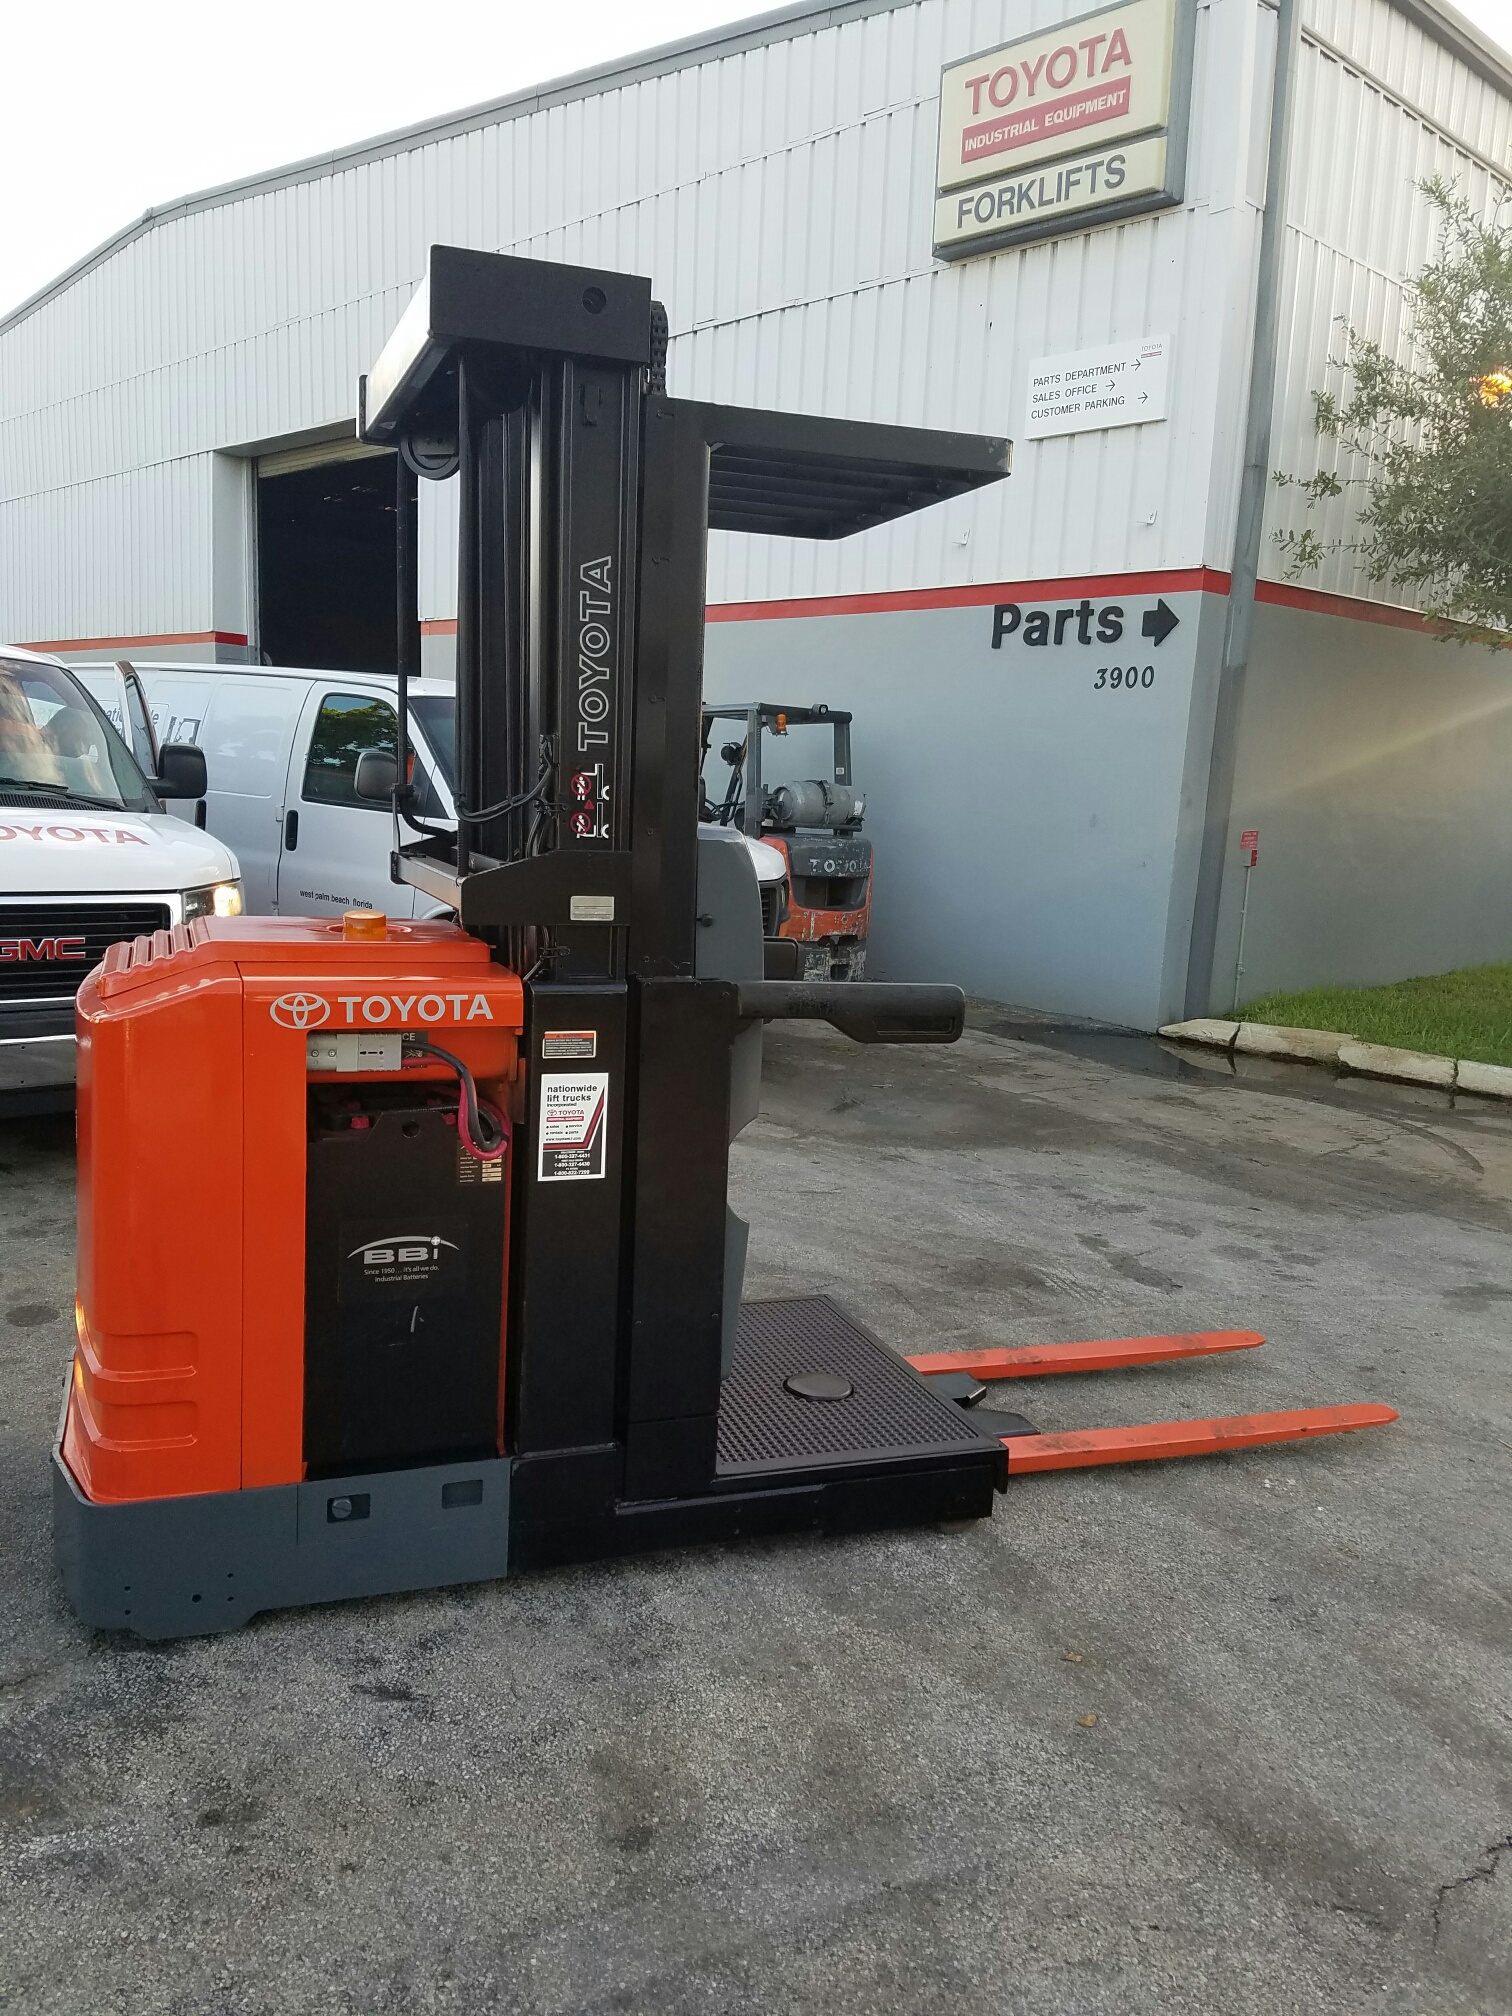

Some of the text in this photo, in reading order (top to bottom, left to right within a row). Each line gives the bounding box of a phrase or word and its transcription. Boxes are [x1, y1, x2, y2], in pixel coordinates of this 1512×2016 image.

[964, 27, 1132, 115] TOYOTA
[964, 88, 1127, 152] INDUSTRIAL EQUIPMENT
[957, 154, 1126, 229] FORKLIFTS
[1141, 343, 1163, 352] TOYOTA
[1033, 361, 1127, 387] PARTS DEPARTMENT
[1032, 383, 1098, 404] SALES OFFICE
[1031, 395, 1125, 419] CUSTOMER PARKING
[991, 600, 1124, 649] Parts
[577, 555, 612, 752] TOYOTA
[1093, 665, 1155, 689] 3900
[299, 889, 373, 909] west palm beach florida
[0, 936, 86, 962] GMC
[337, 993, 494, 1024] TOYOTA
[547, 1084, 598, 1093] nationwide
[547, 1093, 592, 1102] lift trucks
[363, 1268, 380, 1276] Since
[374, 1273, 429, 1283] Industrial Batteries
